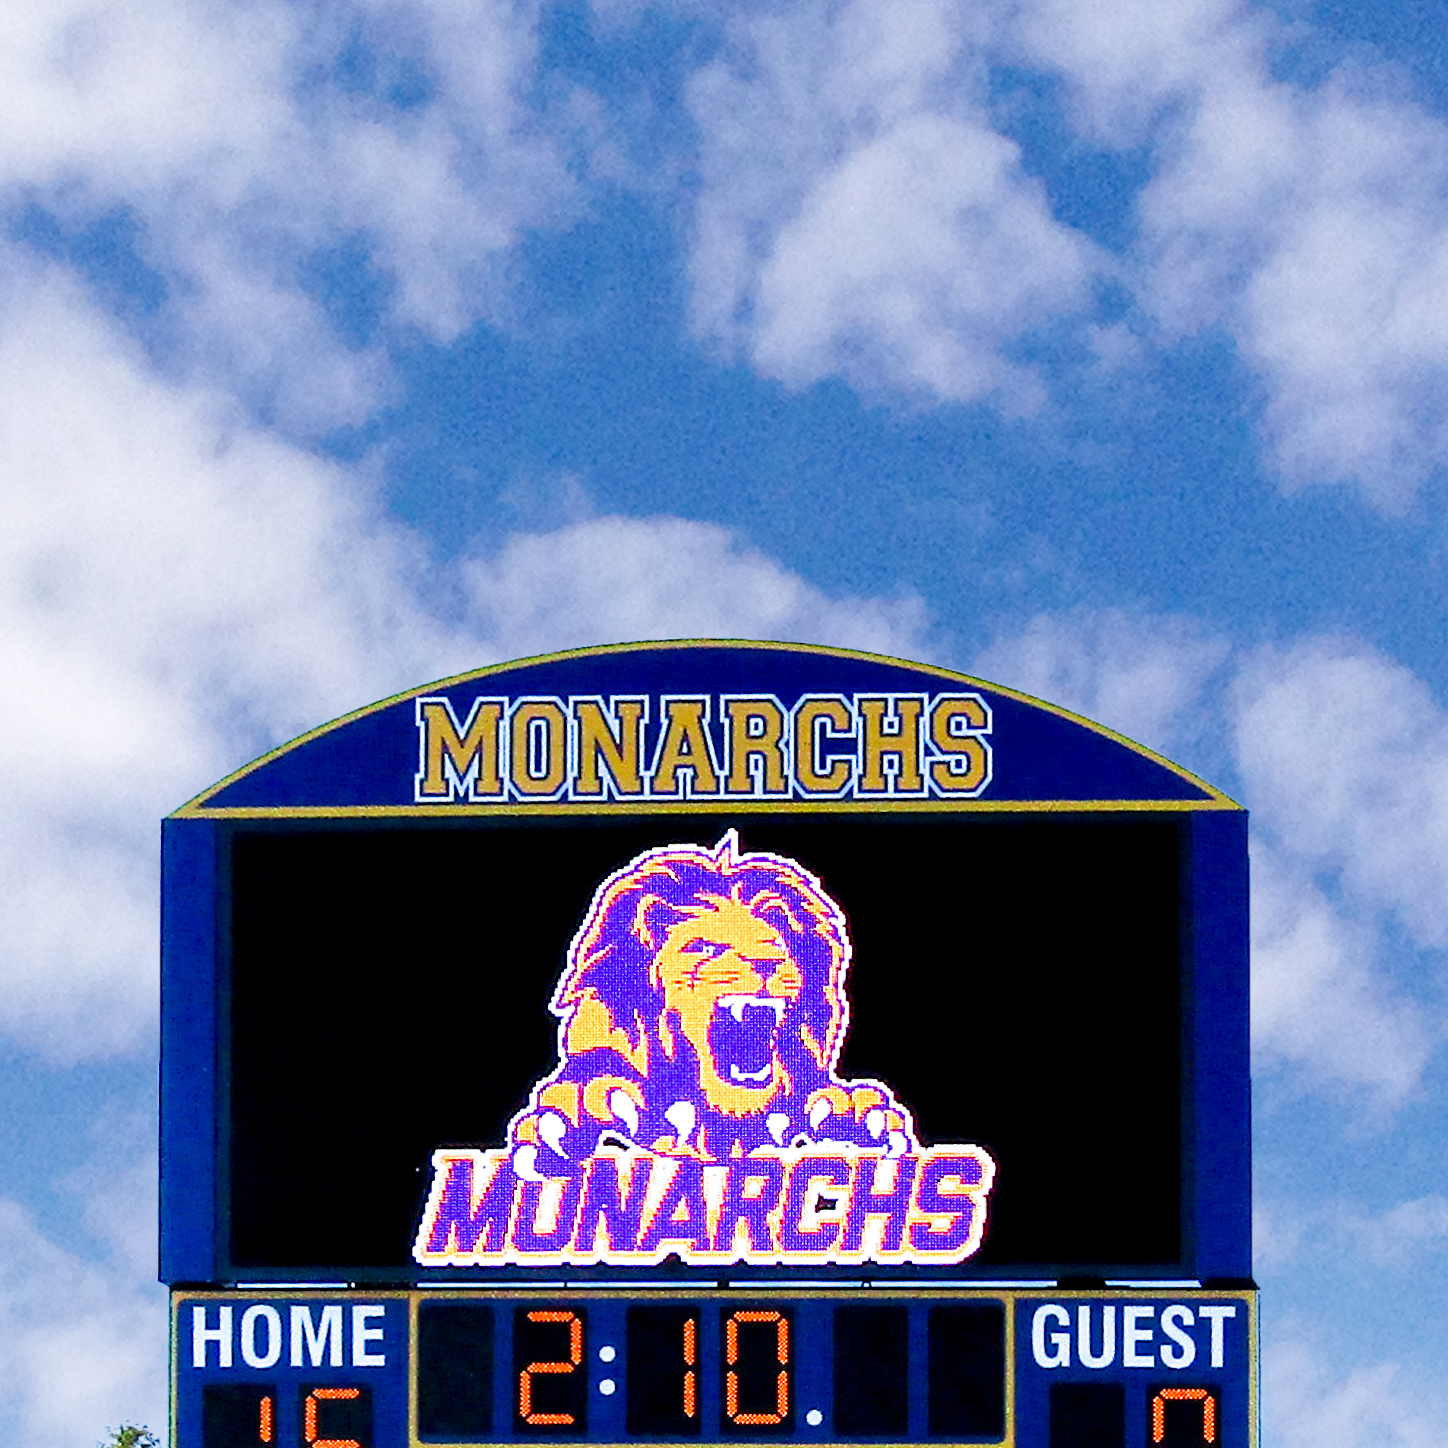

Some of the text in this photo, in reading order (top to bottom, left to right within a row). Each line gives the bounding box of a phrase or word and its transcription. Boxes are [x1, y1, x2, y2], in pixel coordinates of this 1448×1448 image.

[415, 693, 993, 802] MONARCHS
[416, 1150, 992, 1262] MONARCHS
[192, 1305, 386, 1368] HOME
[1032, 1305, 1236, 1369] GUEST
